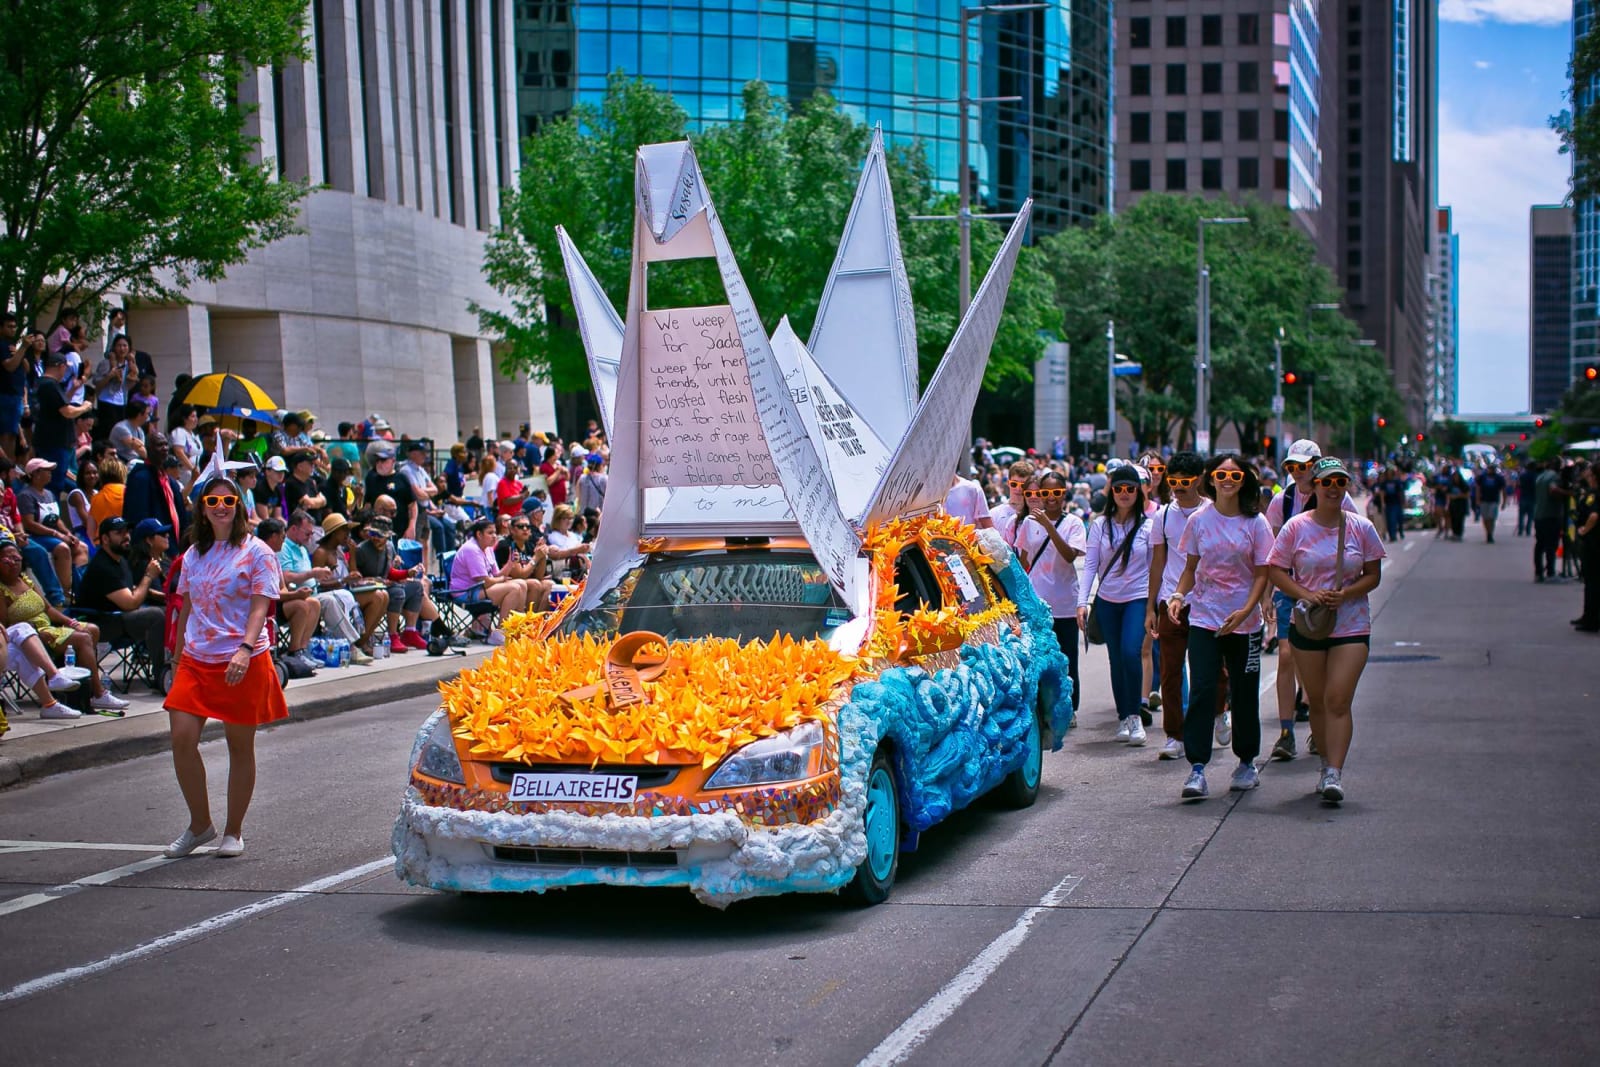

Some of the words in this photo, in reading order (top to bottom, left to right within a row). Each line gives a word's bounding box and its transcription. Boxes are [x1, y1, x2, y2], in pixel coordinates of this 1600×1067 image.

[654, 312, 679, 330] We
[692, 315, 724, 328] weep
[662, 333, 688, 352] for
[650, 365, 687, 374] weep
[692, 356, 712, 371] for
[720, 355, 745, 367] her
[707, 372, 736, 387] until
[655, 391, 706, 409] blasted
[717, 389, 748, 406] flesh
[691, 408, 714, 424] for
[720, 410, 746, 424] still
[648, 434, 669, 447] the
[674, 433, 704, 442] news
[710, 426, 721, 443] of
[724, 431, 750, 446] rage
[682, 448, 702, 463] still
[706, 451, 741, 463] comes
[746, 448, 771, 464] hope
[651, 468, 669, 485] the
[685, 464, 724, 486] folding
[732, 463, 745, 482] of
[694, 498, 717, 511] to
[731, 496, 785, 508] me
